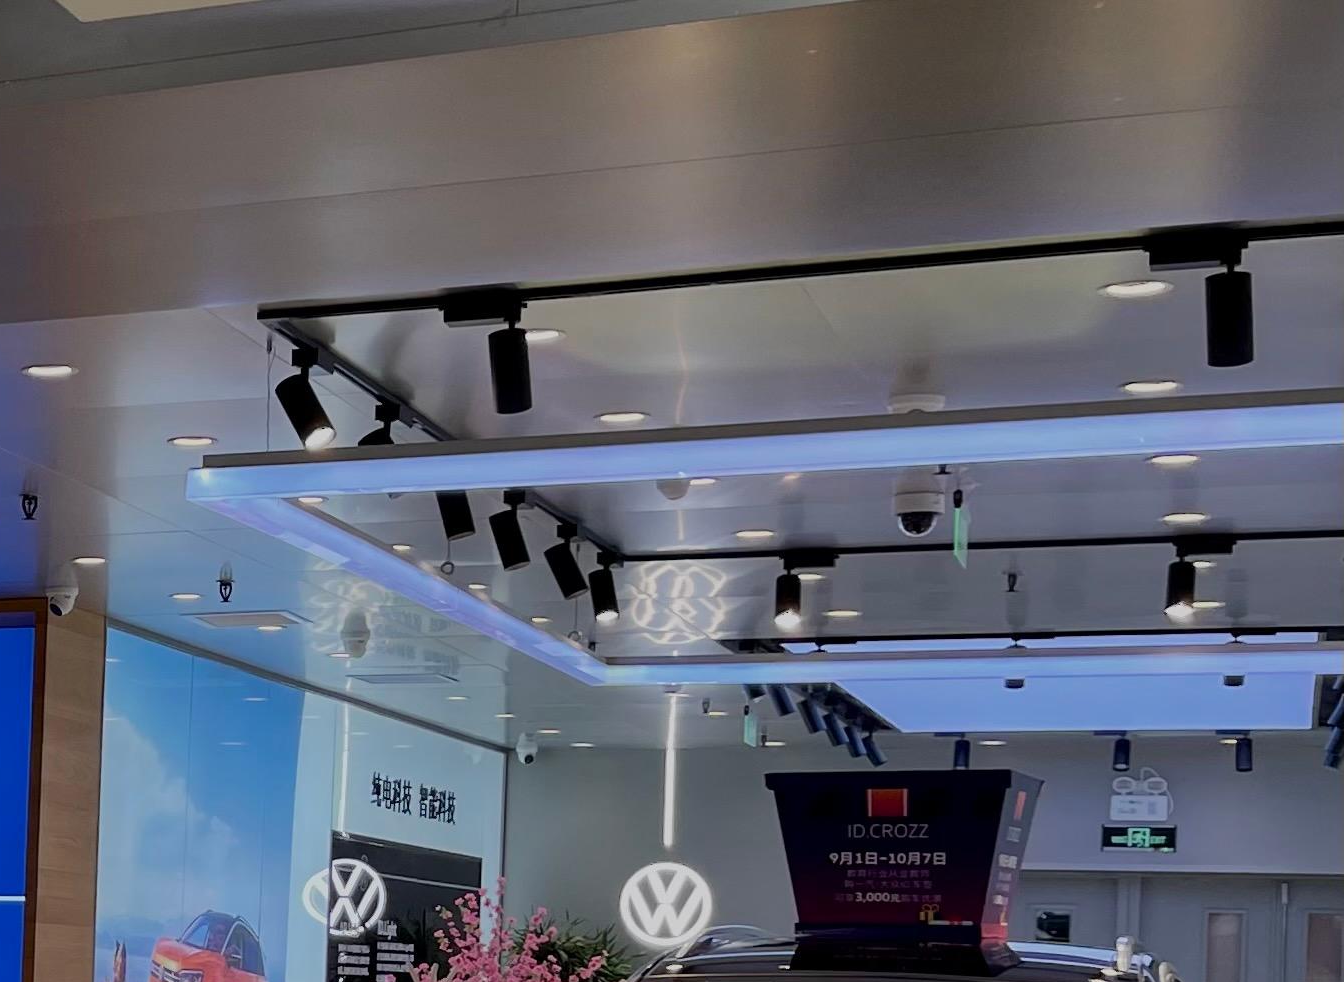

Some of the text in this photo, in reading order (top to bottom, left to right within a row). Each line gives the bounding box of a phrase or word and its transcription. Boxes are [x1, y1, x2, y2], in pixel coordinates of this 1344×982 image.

[848, 823, 930, 839] ID.CROZZ
[829, 852, 946, 865] 9月1日-10月7日
